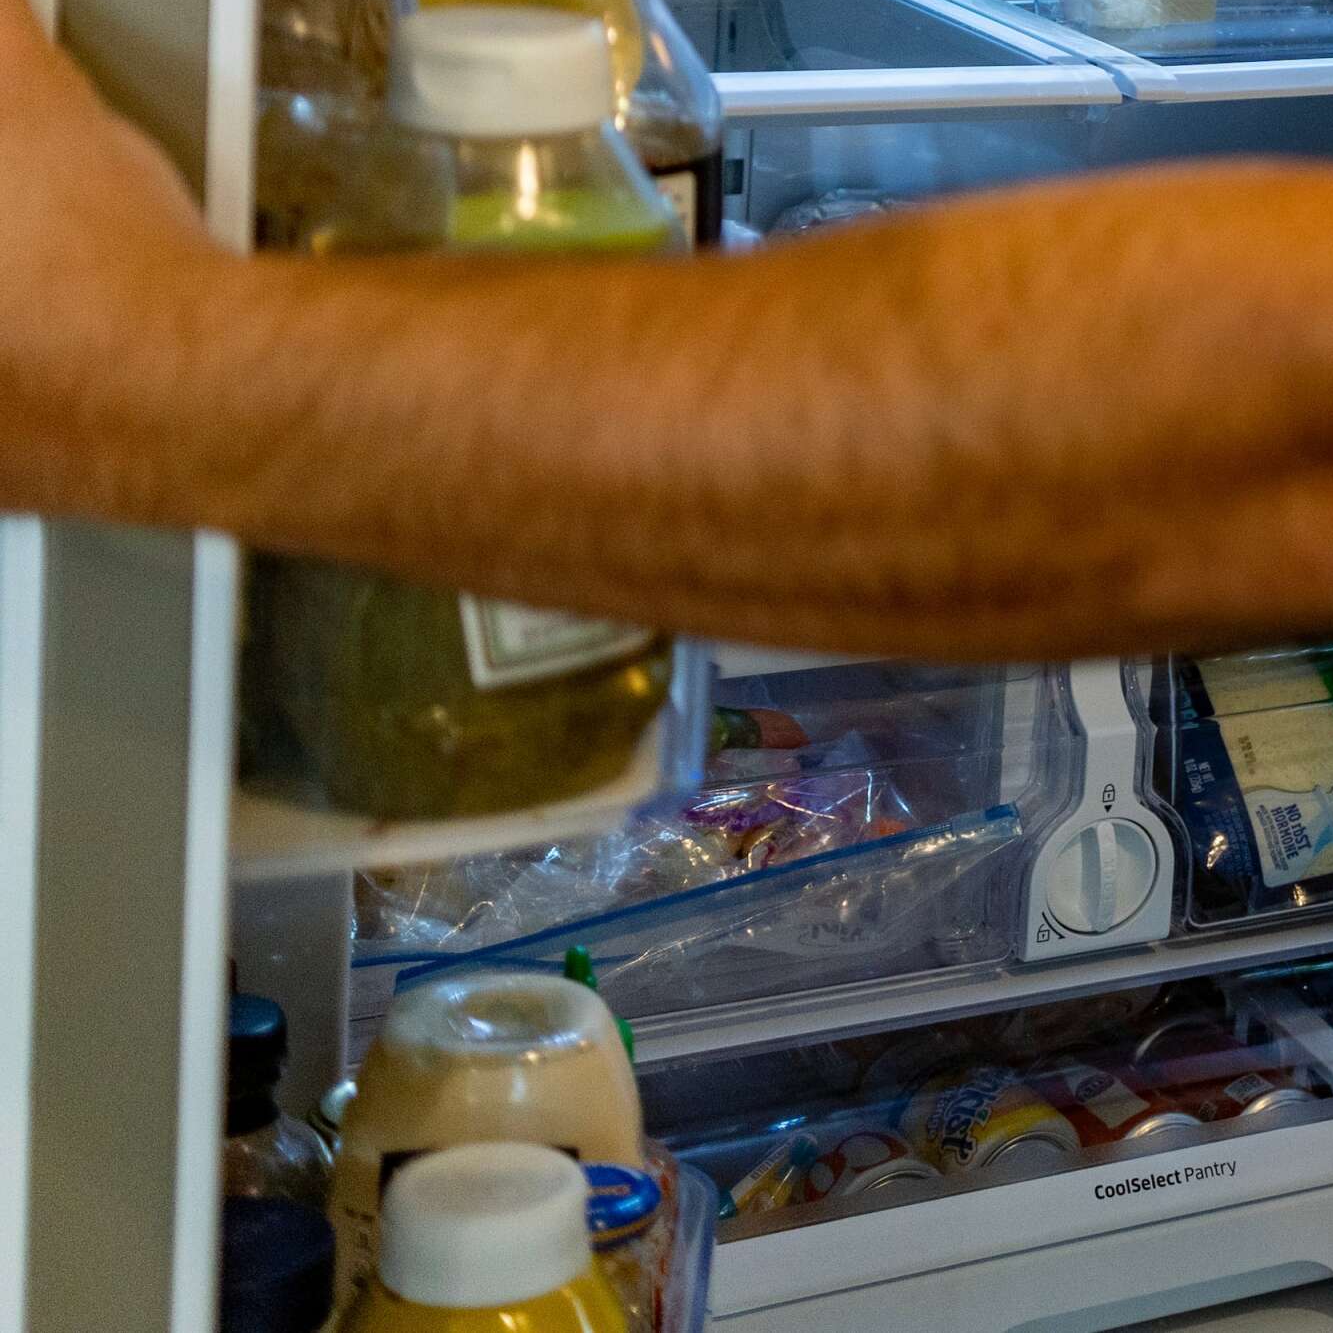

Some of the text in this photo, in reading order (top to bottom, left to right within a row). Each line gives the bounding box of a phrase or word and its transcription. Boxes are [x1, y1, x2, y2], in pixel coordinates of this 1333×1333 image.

[1270, 805, 1300, 861] HORMONE
[1284, 803, 1312, 851] NO rbST
[1094, 1160, 1237, 1200] CoolSelect Pantry
